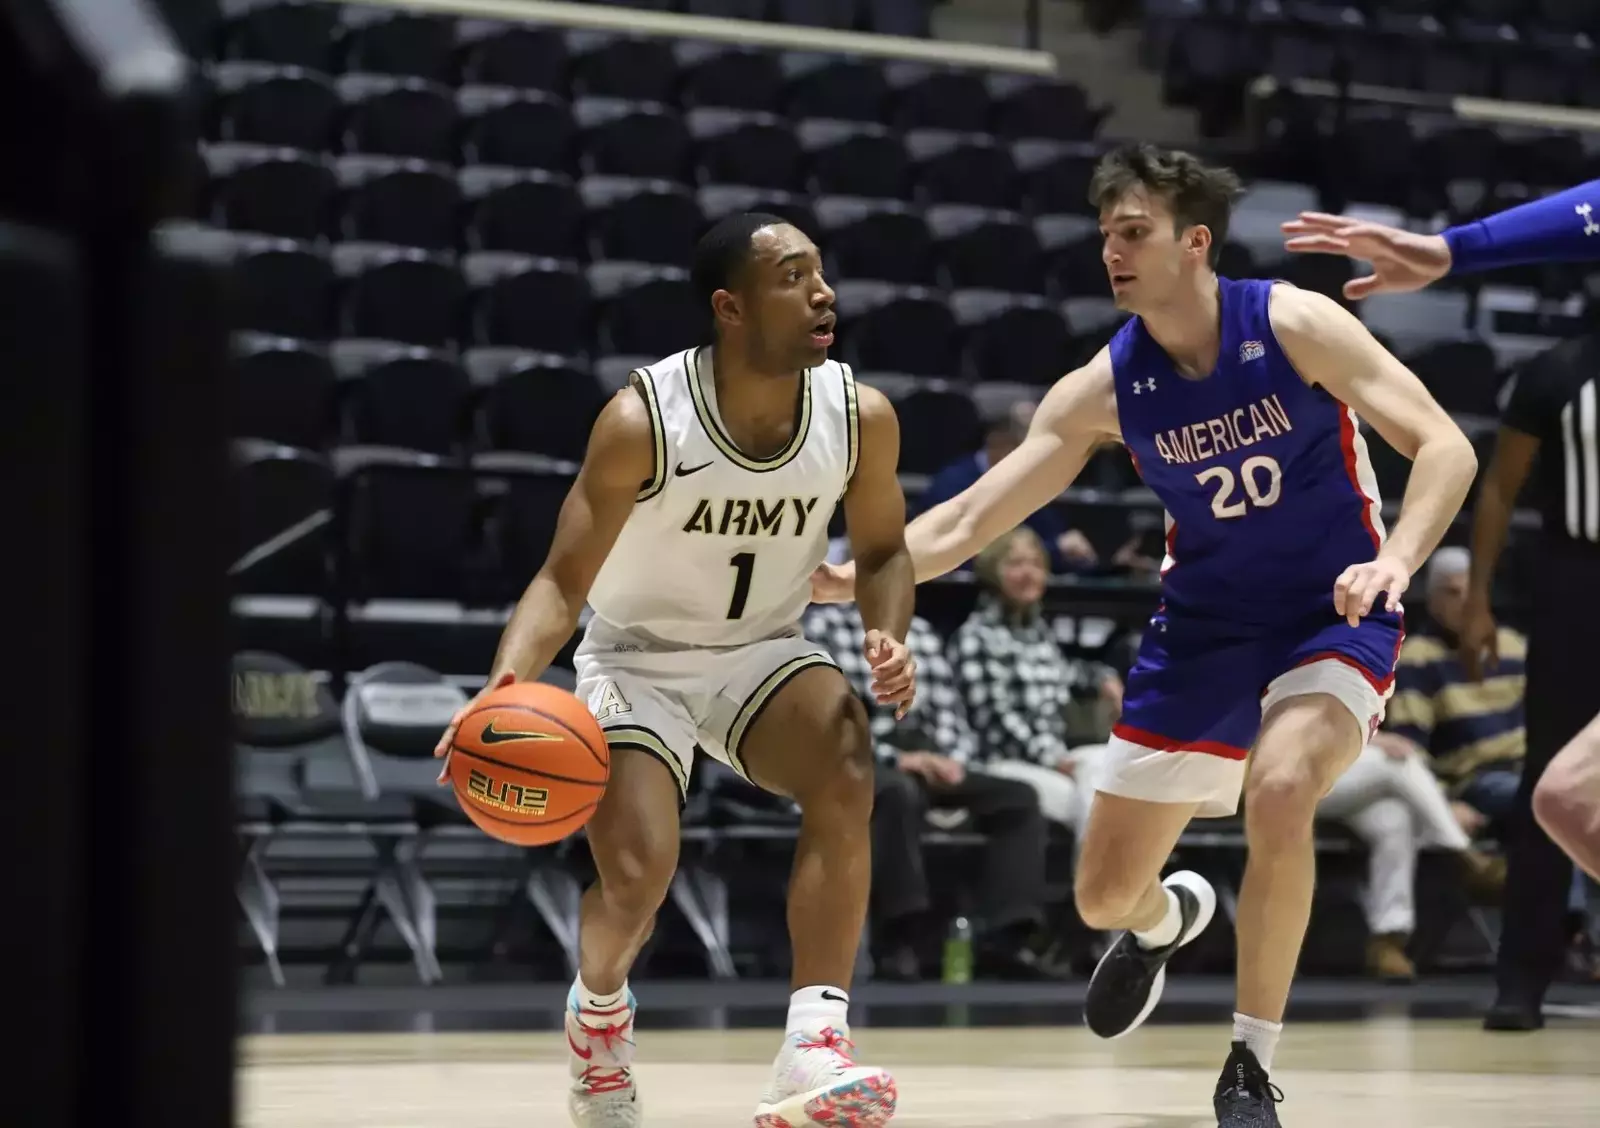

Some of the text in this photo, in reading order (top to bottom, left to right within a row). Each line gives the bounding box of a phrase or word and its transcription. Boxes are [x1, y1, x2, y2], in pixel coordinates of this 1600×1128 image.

[1155, 394, 1292, 464] AMERICAN
[1195, 455, 1282, 519] 20
[682, 496, 819, 537] ARMY
[727, 552, 756, 620] 1
[595, 681, 632, 721] A
[467, 790, 546, 815] CHAMPIONSHIP
